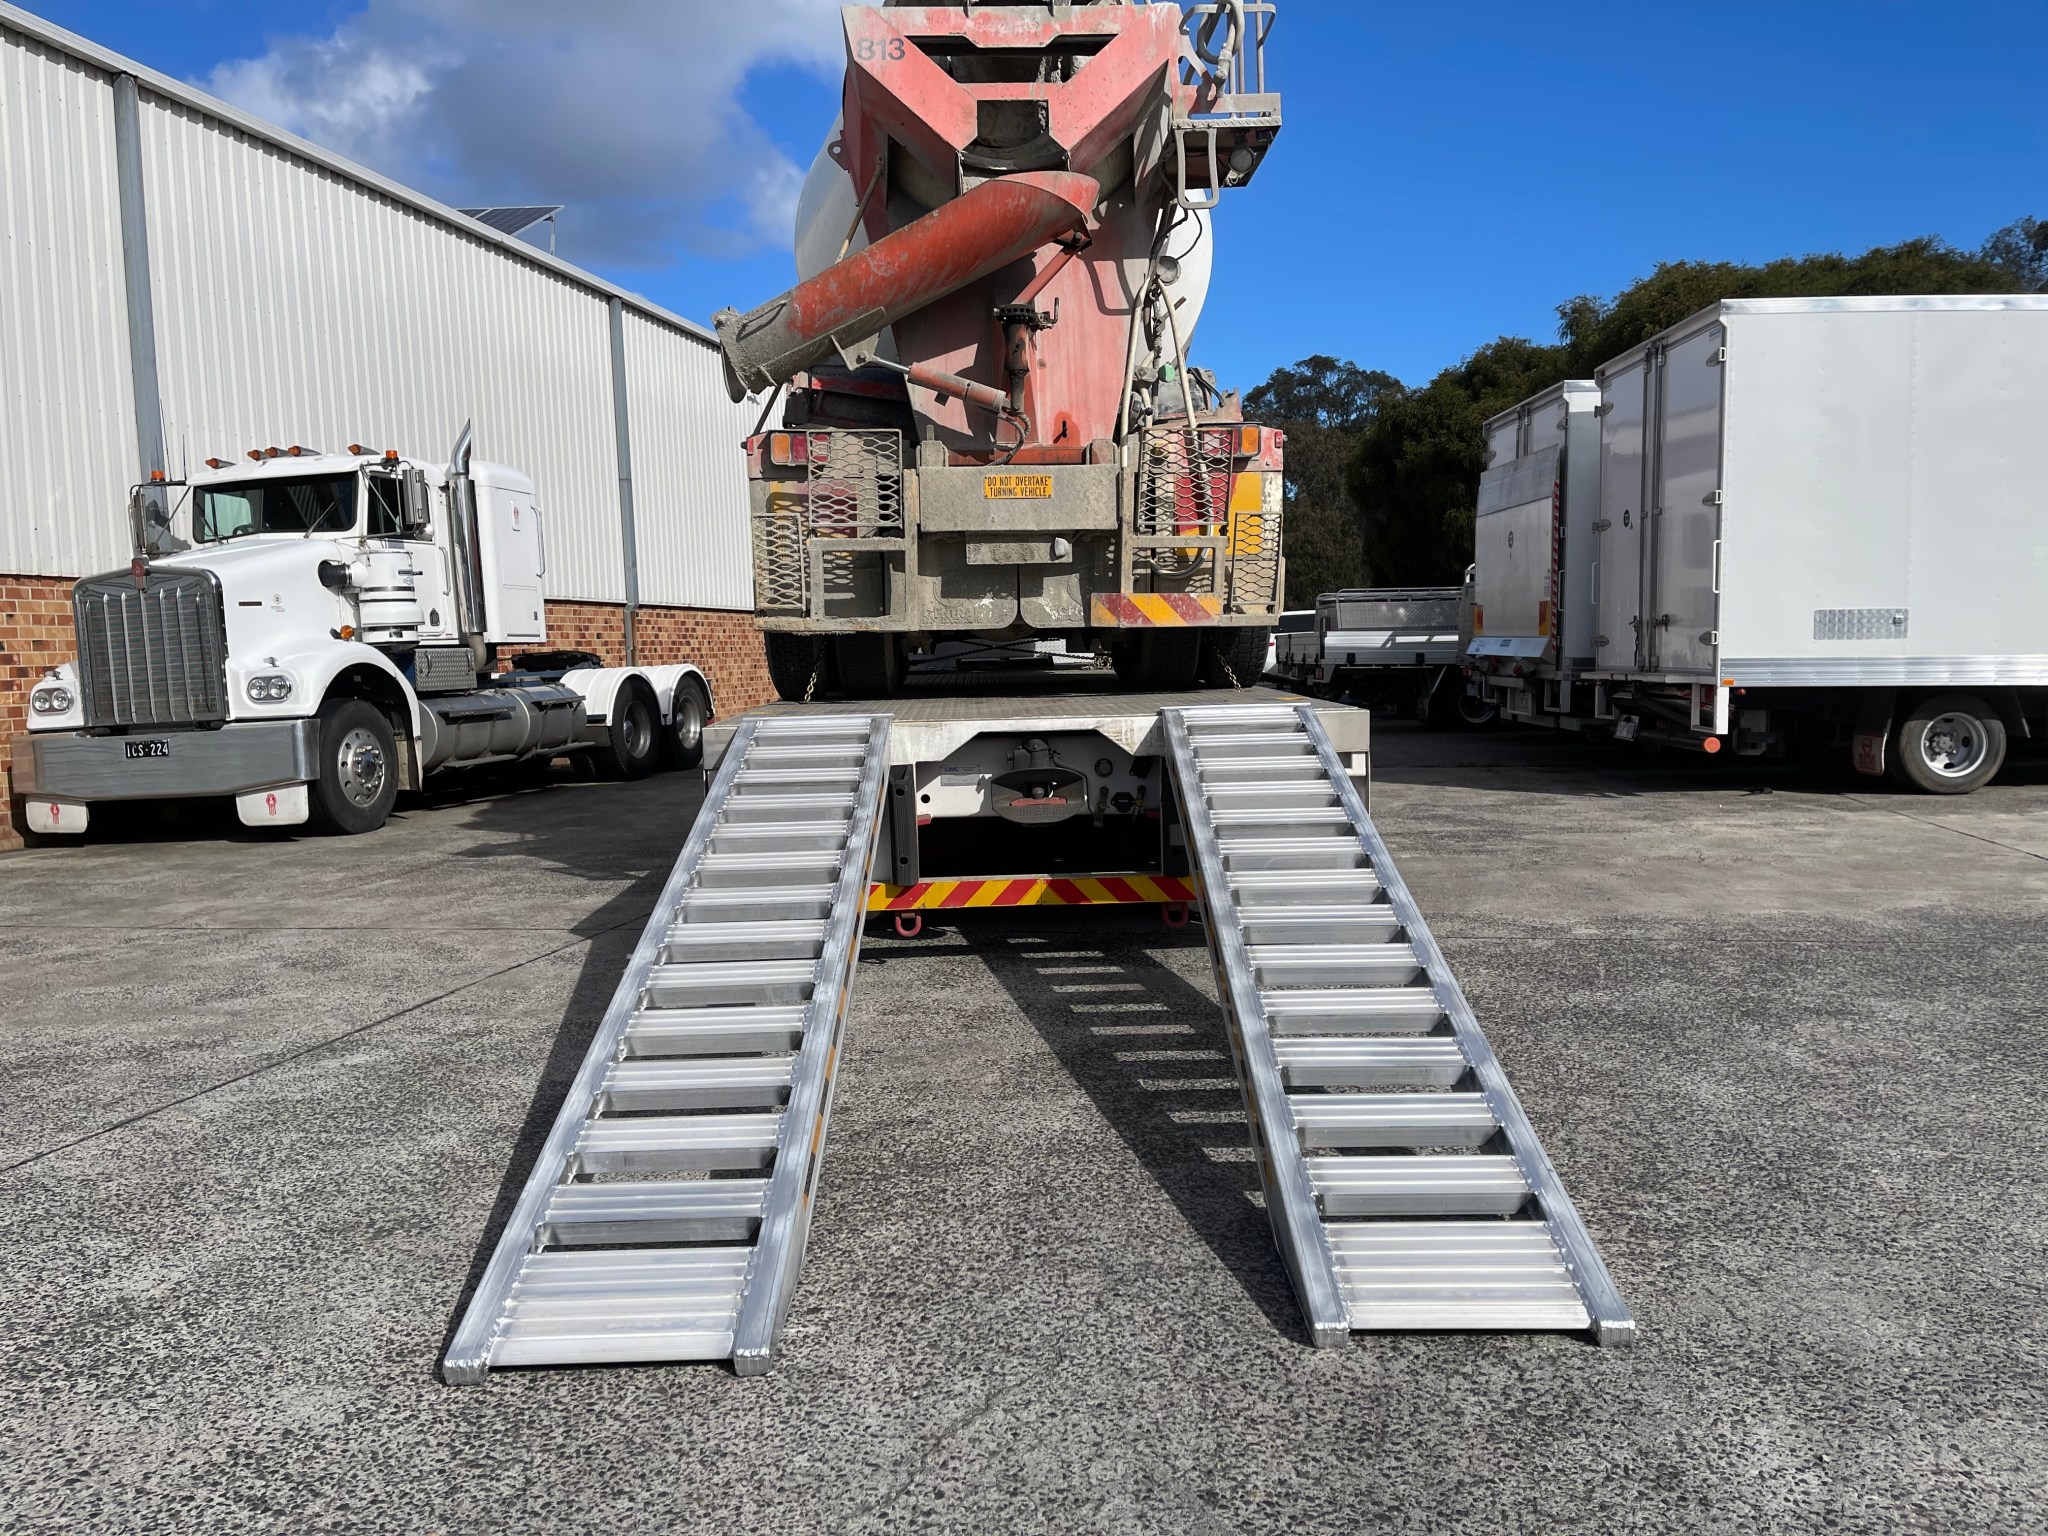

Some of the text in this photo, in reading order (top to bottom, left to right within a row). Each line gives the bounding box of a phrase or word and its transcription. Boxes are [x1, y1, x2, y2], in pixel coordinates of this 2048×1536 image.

[857, 37, 906, 61] 813
[987, 475, 1049, 487] DO NOT OVERTAKE
[989, 486, 1047, 497] TURNING VEHICLE
